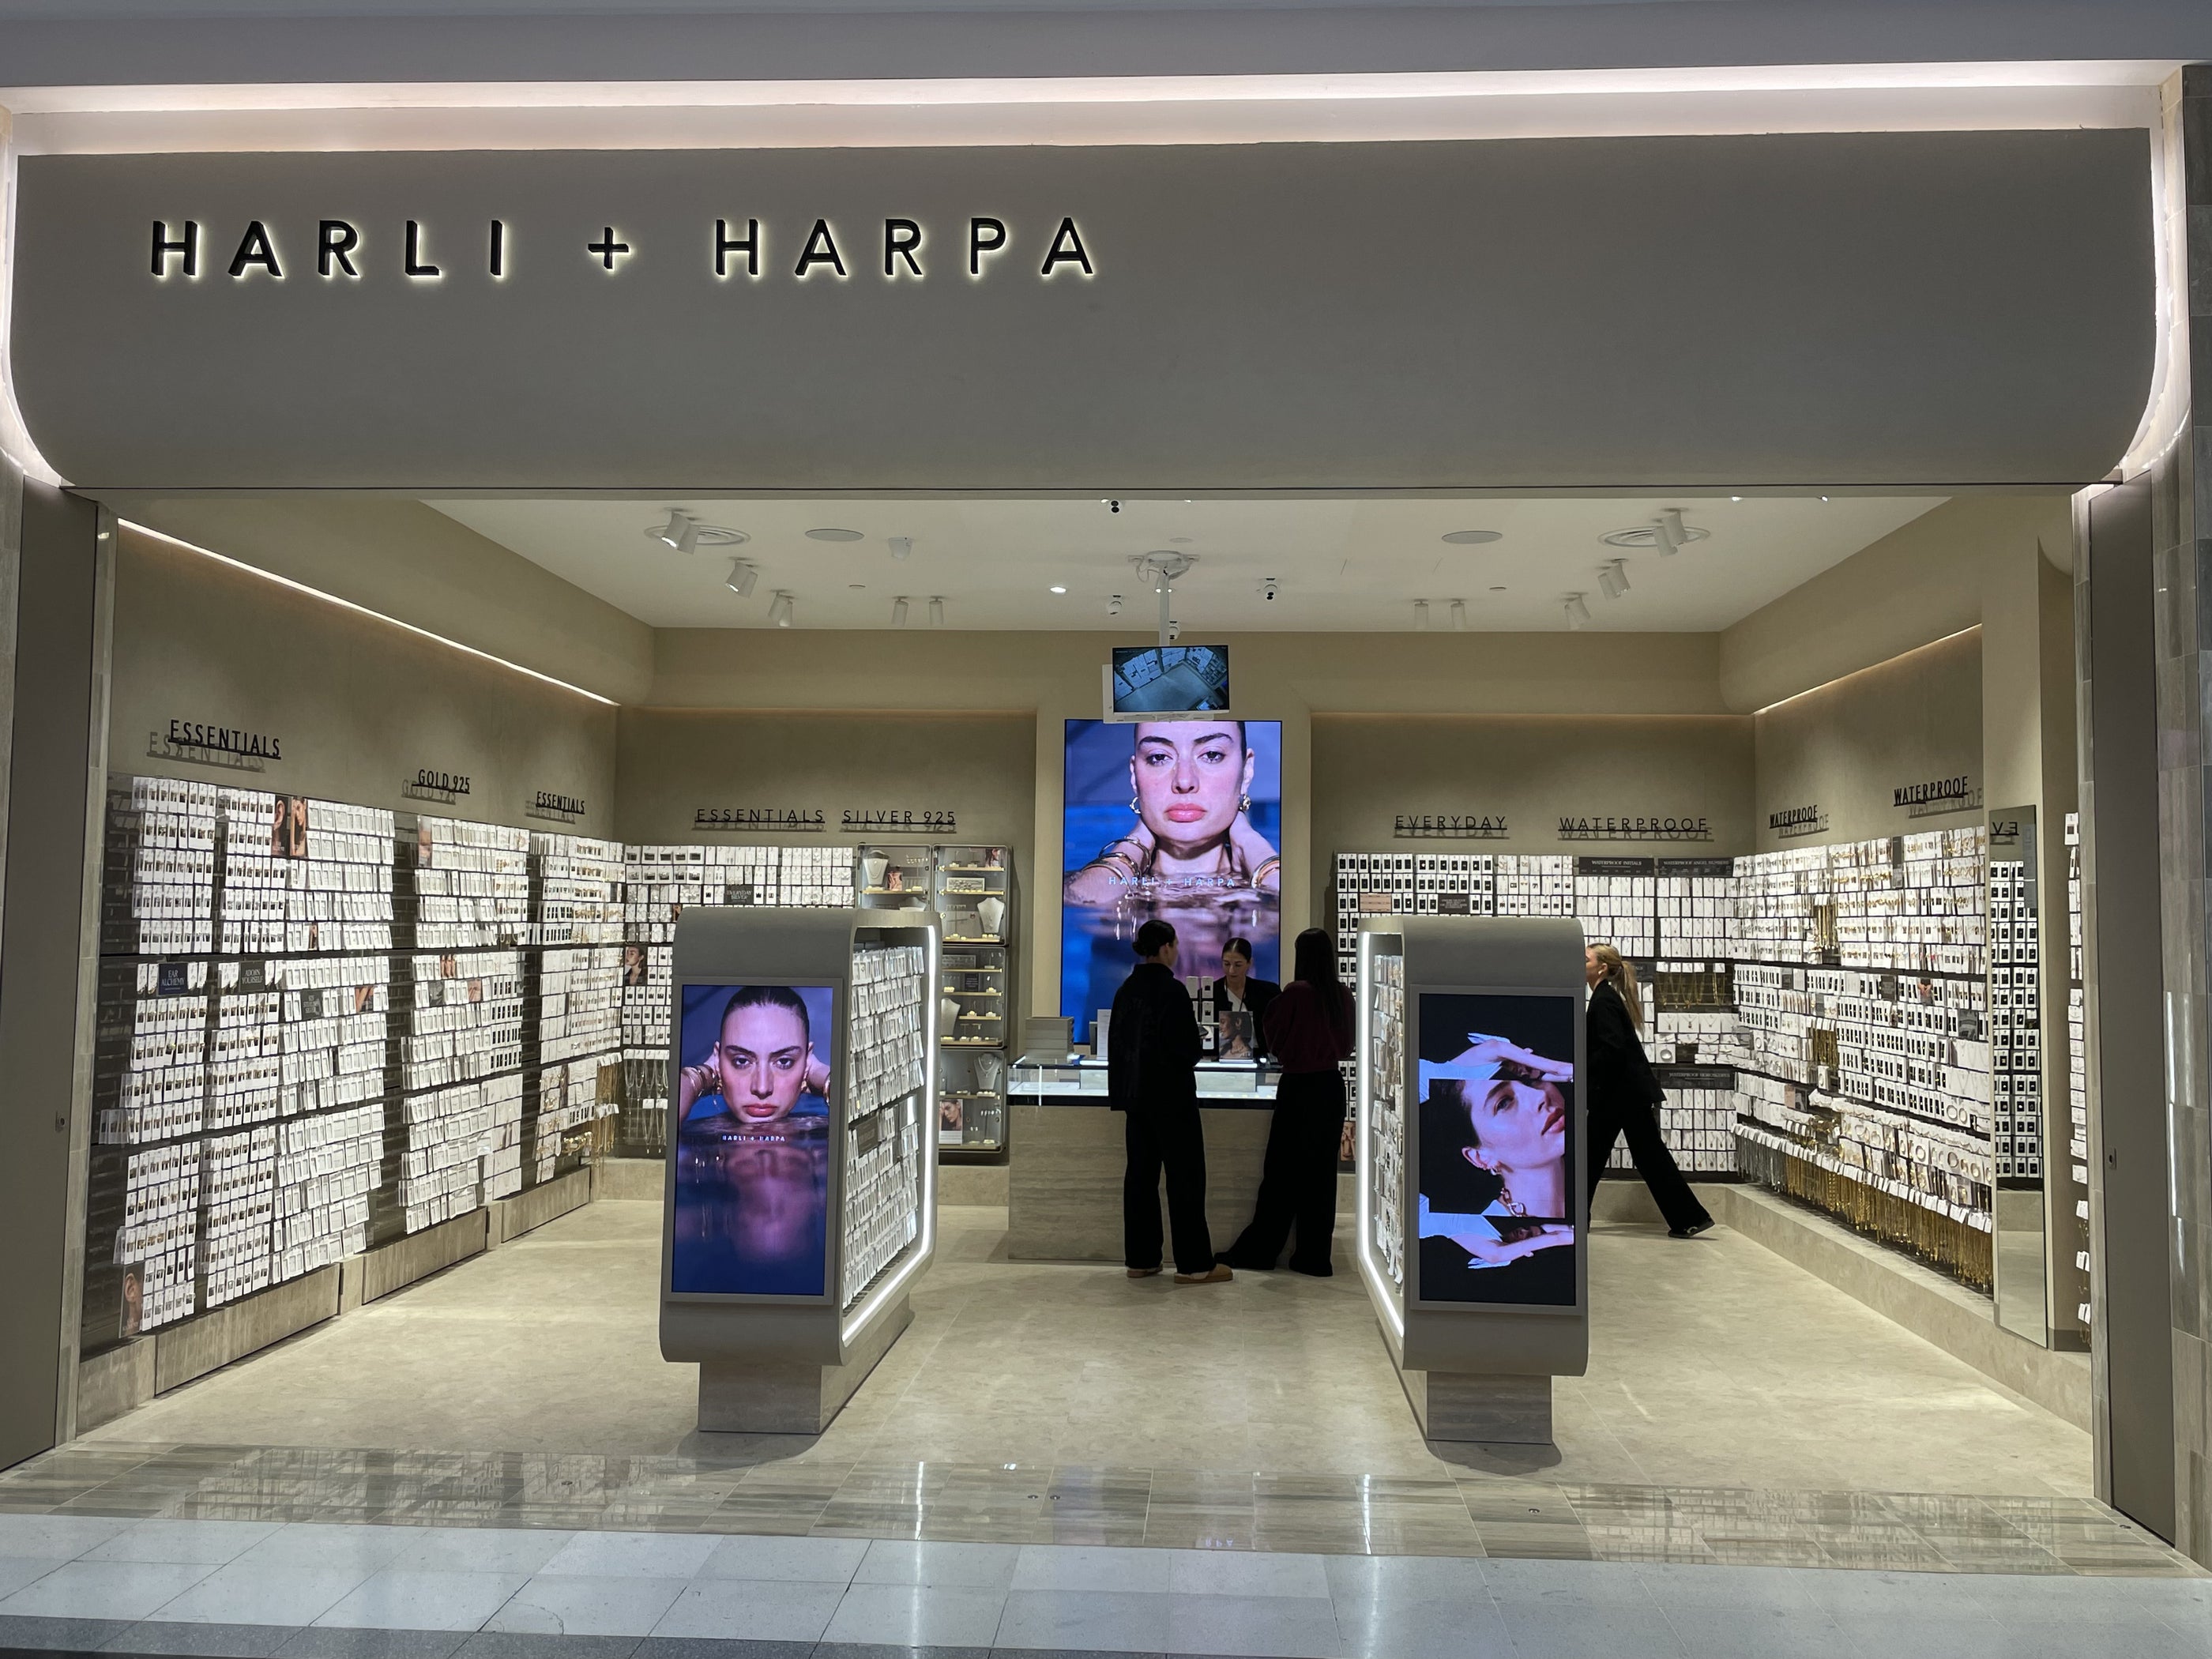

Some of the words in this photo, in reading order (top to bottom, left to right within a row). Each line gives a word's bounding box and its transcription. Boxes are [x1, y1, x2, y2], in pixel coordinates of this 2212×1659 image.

[151, 219, 506, 278] HARLI
[588, 226, 630, 270] +
[715, 216, 1094, 277] HARPA
[170, 719, 280, 759] ESSENTIALS
[418, 769, 450, 788] GOLD
[453, 775, 471, 792] 925
[1894, 776, 1969, 807] WATERPROOF
[536, 791, 585, 814] ESSENTIALS
[697, 808, 824, 822] ESSENTIALS
[843, 810, 912, 822] SILVER
[924, 811, 955, 823] 925
[1396, 815, 1507, 828] EVERYDAY
[1559, 816, 1707, 831] WATERPROOF
[1769, 804, 1818, 828] WATERPROOF
[1108, 876, 1155, 886] HARLI
[1184, 878, 1236, 886] HARPA
[162, 977, 185, 987] ALCHEMY
